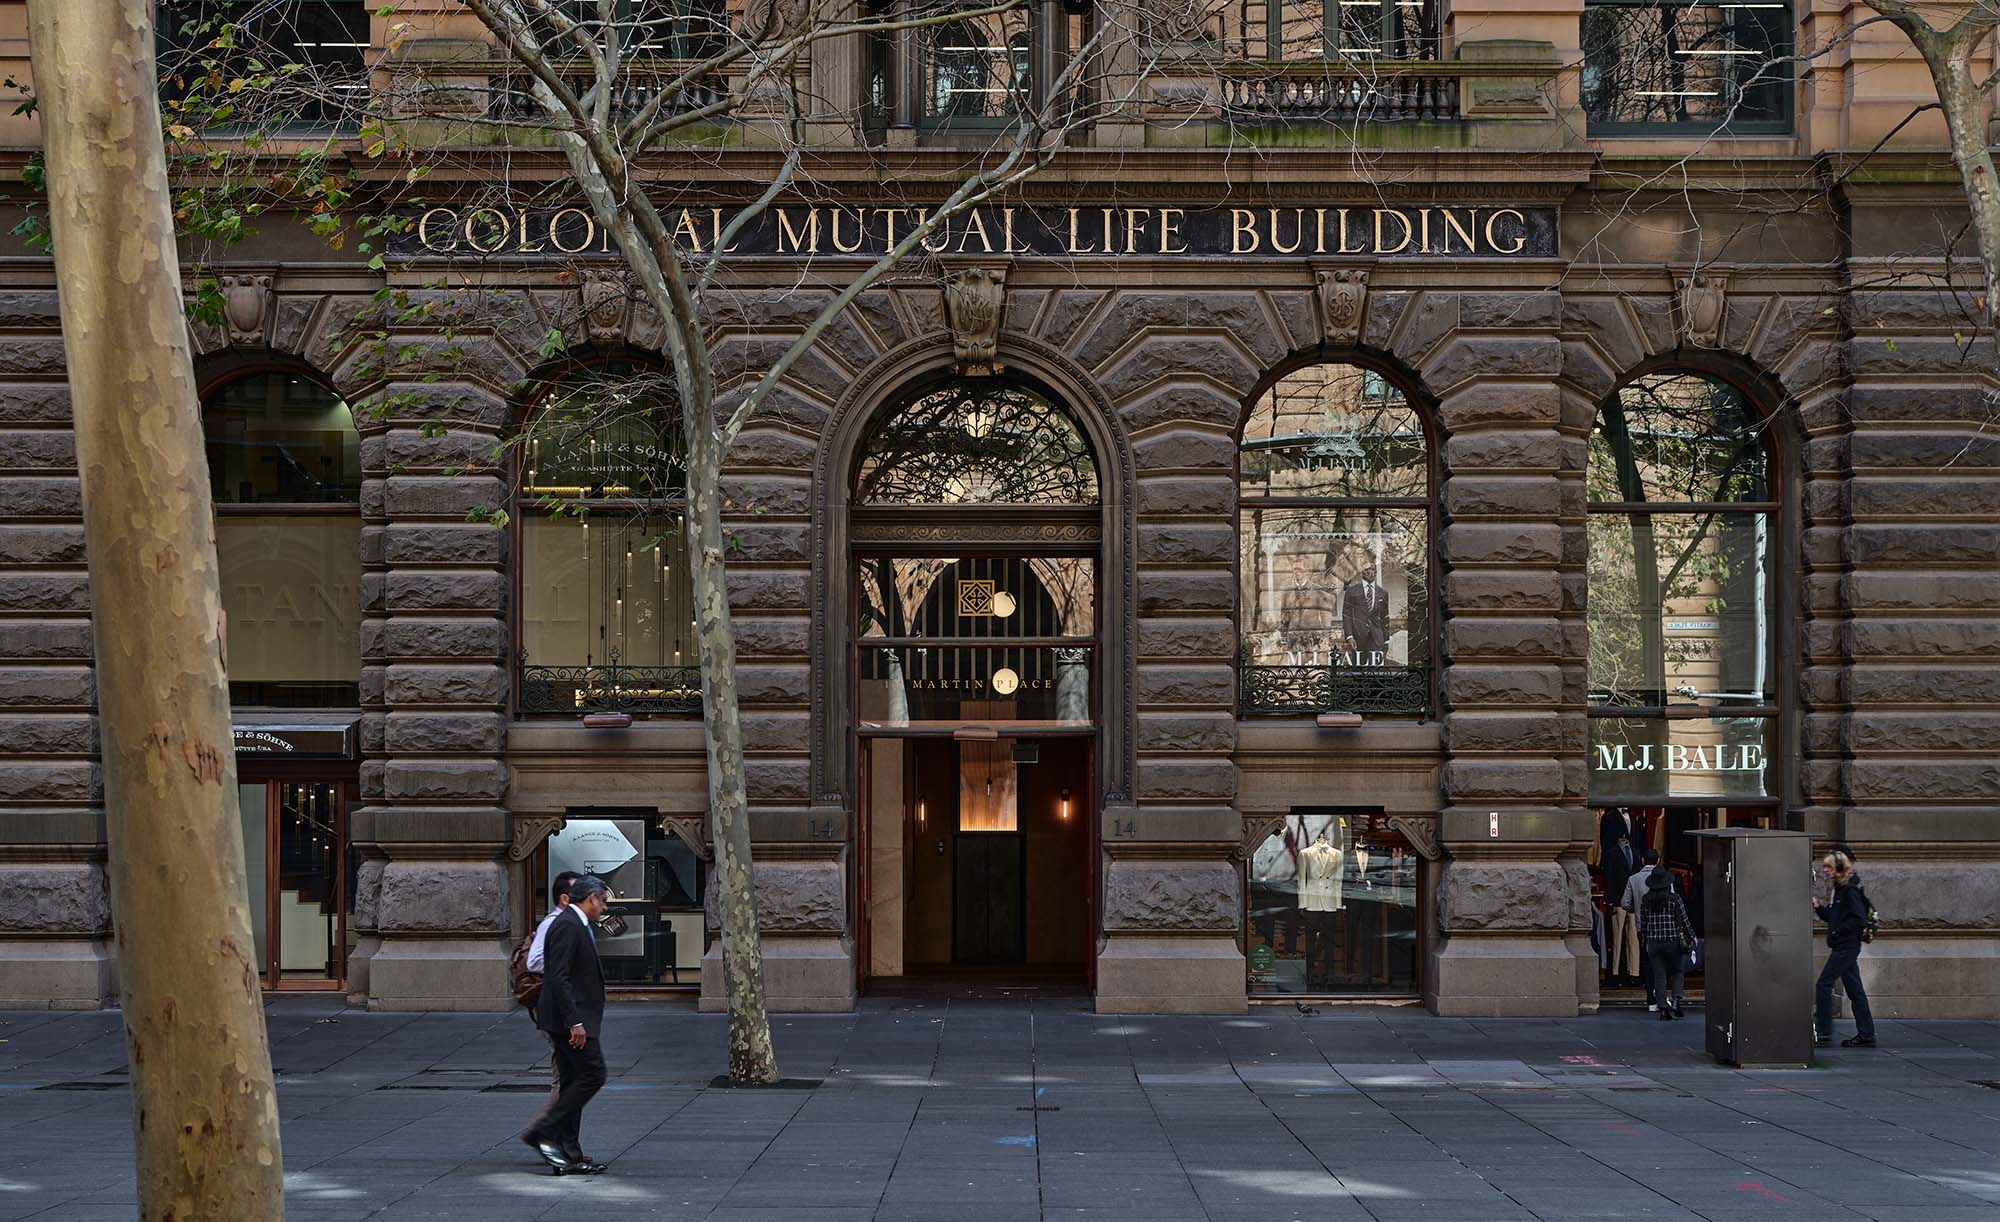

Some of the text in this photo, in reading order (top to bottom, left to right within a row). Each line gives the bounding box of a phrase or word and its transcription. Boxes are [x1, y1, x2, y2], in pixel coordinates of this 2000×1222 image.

[418, 207, 1526, 254] COLOAL MUTUAL LIFE BUILDING
[912, 679, 984, 689] MARTIN
[997, 679, 1052, 689] PLACE
[245, 731, 255, 739] &
[256, 733, 294, 751] SÖHNE
[1595, 744, 1763, 771] M.J. BALE
[808, 817, 833, 839] 14
[1113, 816, 1137, 839] 14
